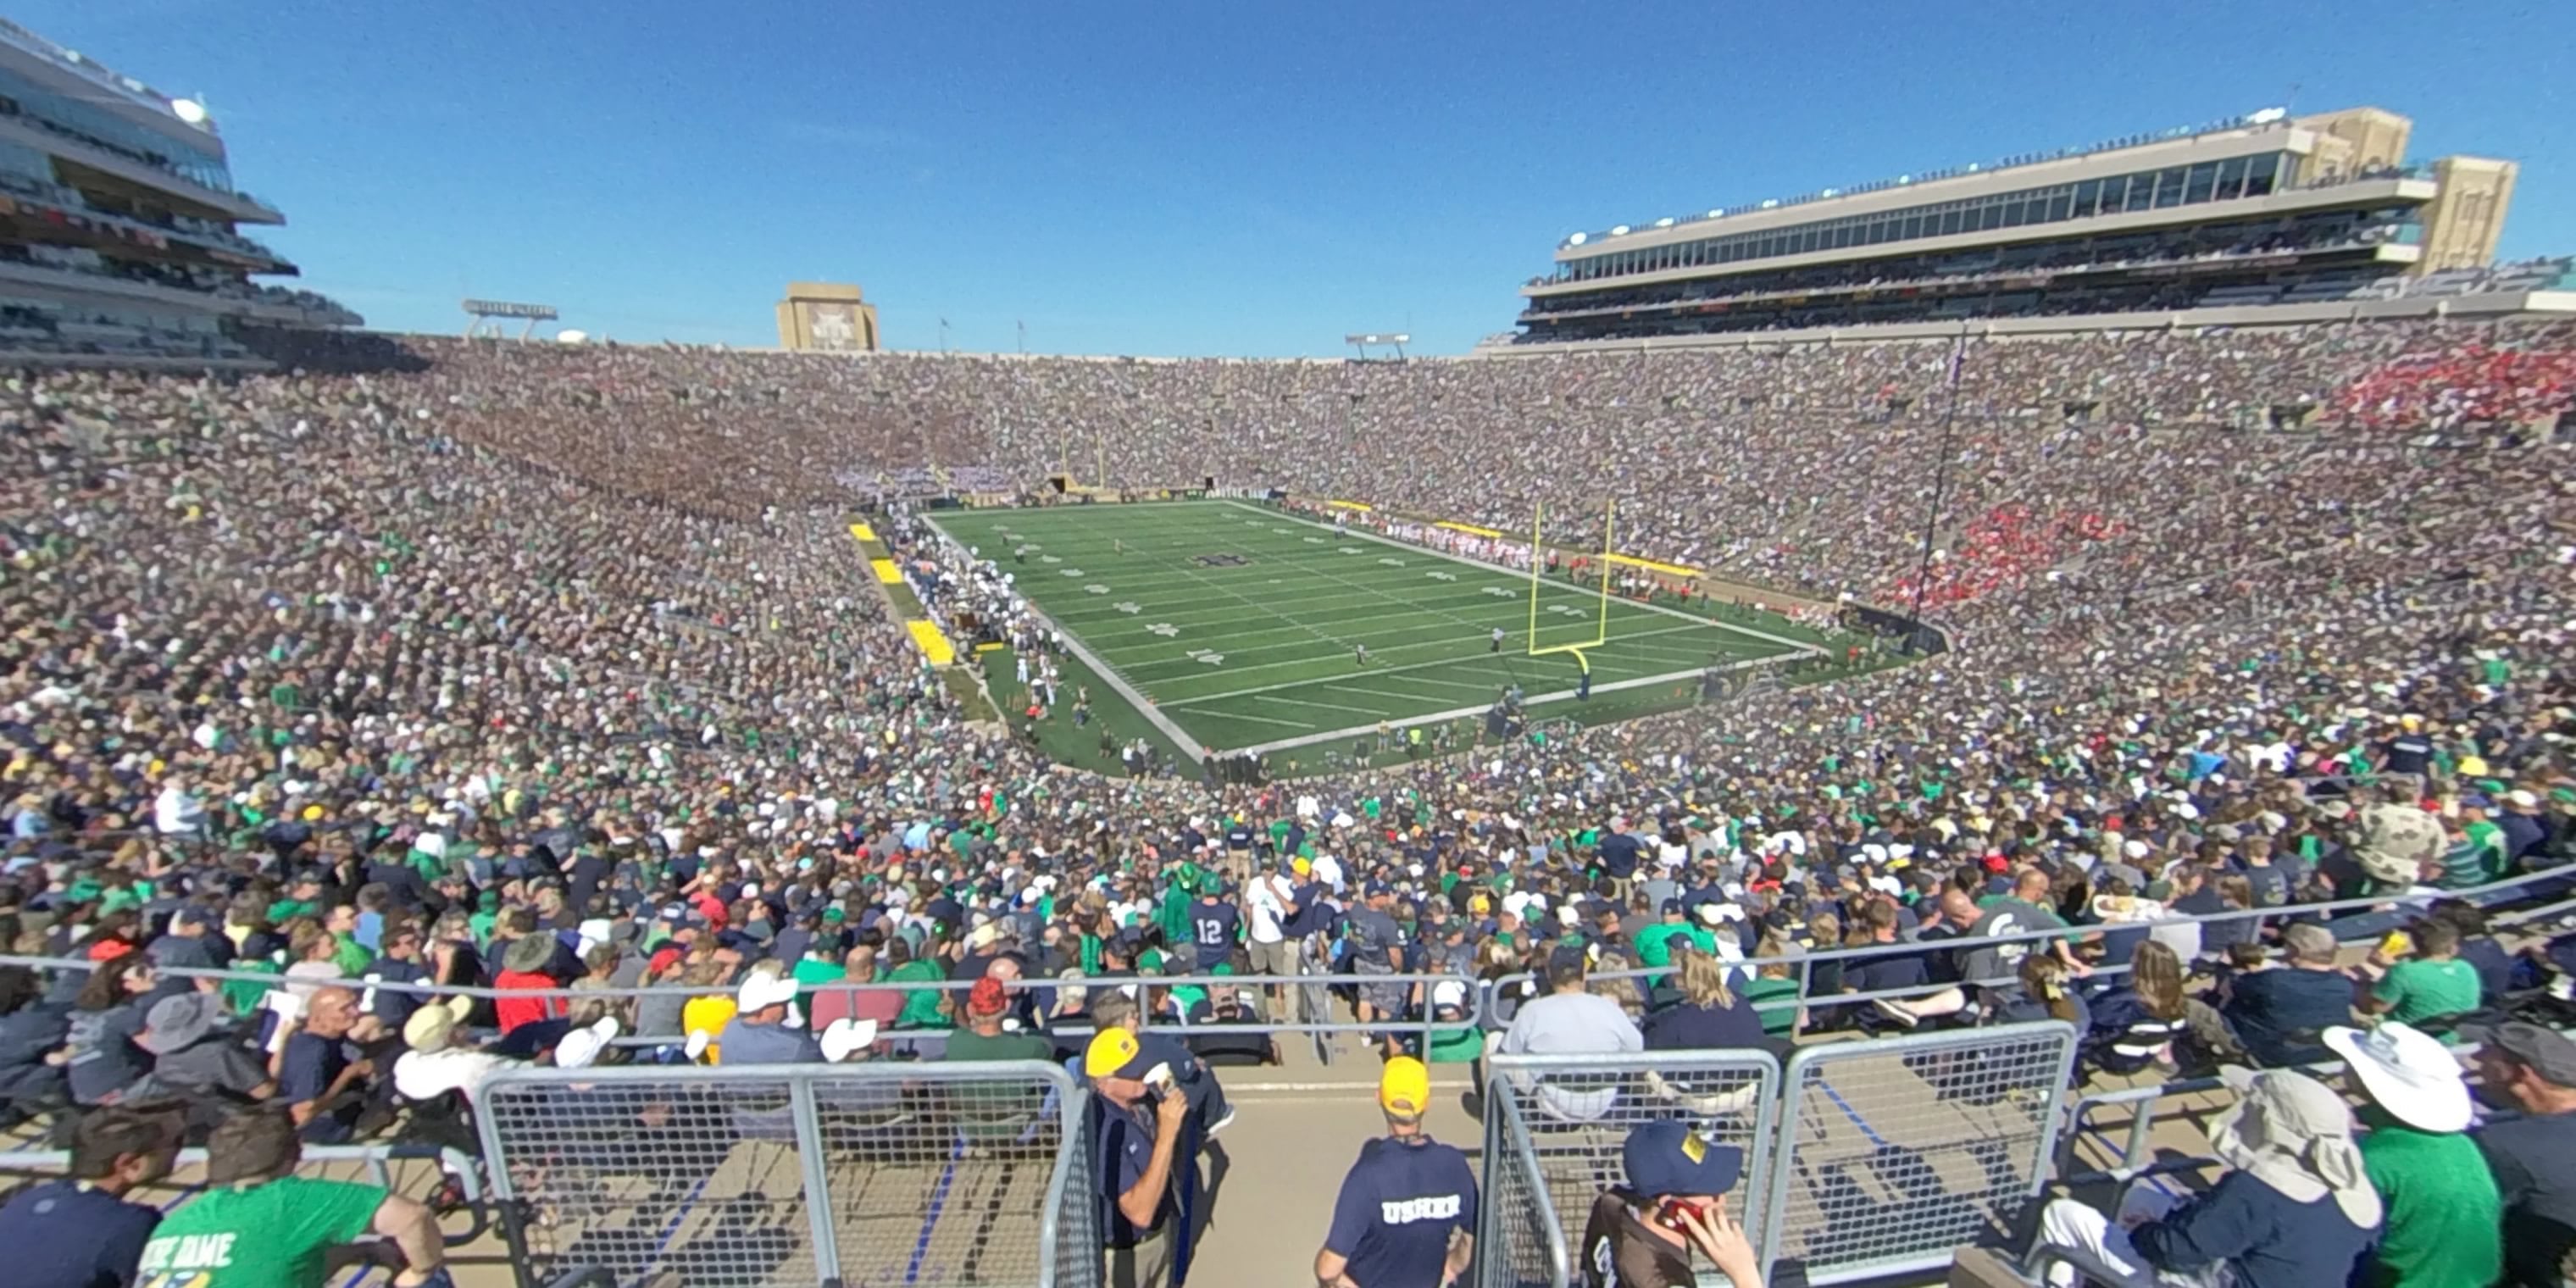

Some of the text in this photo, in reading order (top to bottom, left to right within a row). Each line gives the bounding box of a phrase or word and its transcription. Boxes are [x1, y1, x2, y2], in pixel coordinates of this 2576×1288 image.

[1196, 918, 1223, 945] 12
[1381, 1193, 1461, 1224] USHER
[171, 1231, 237, 1269] DAME
